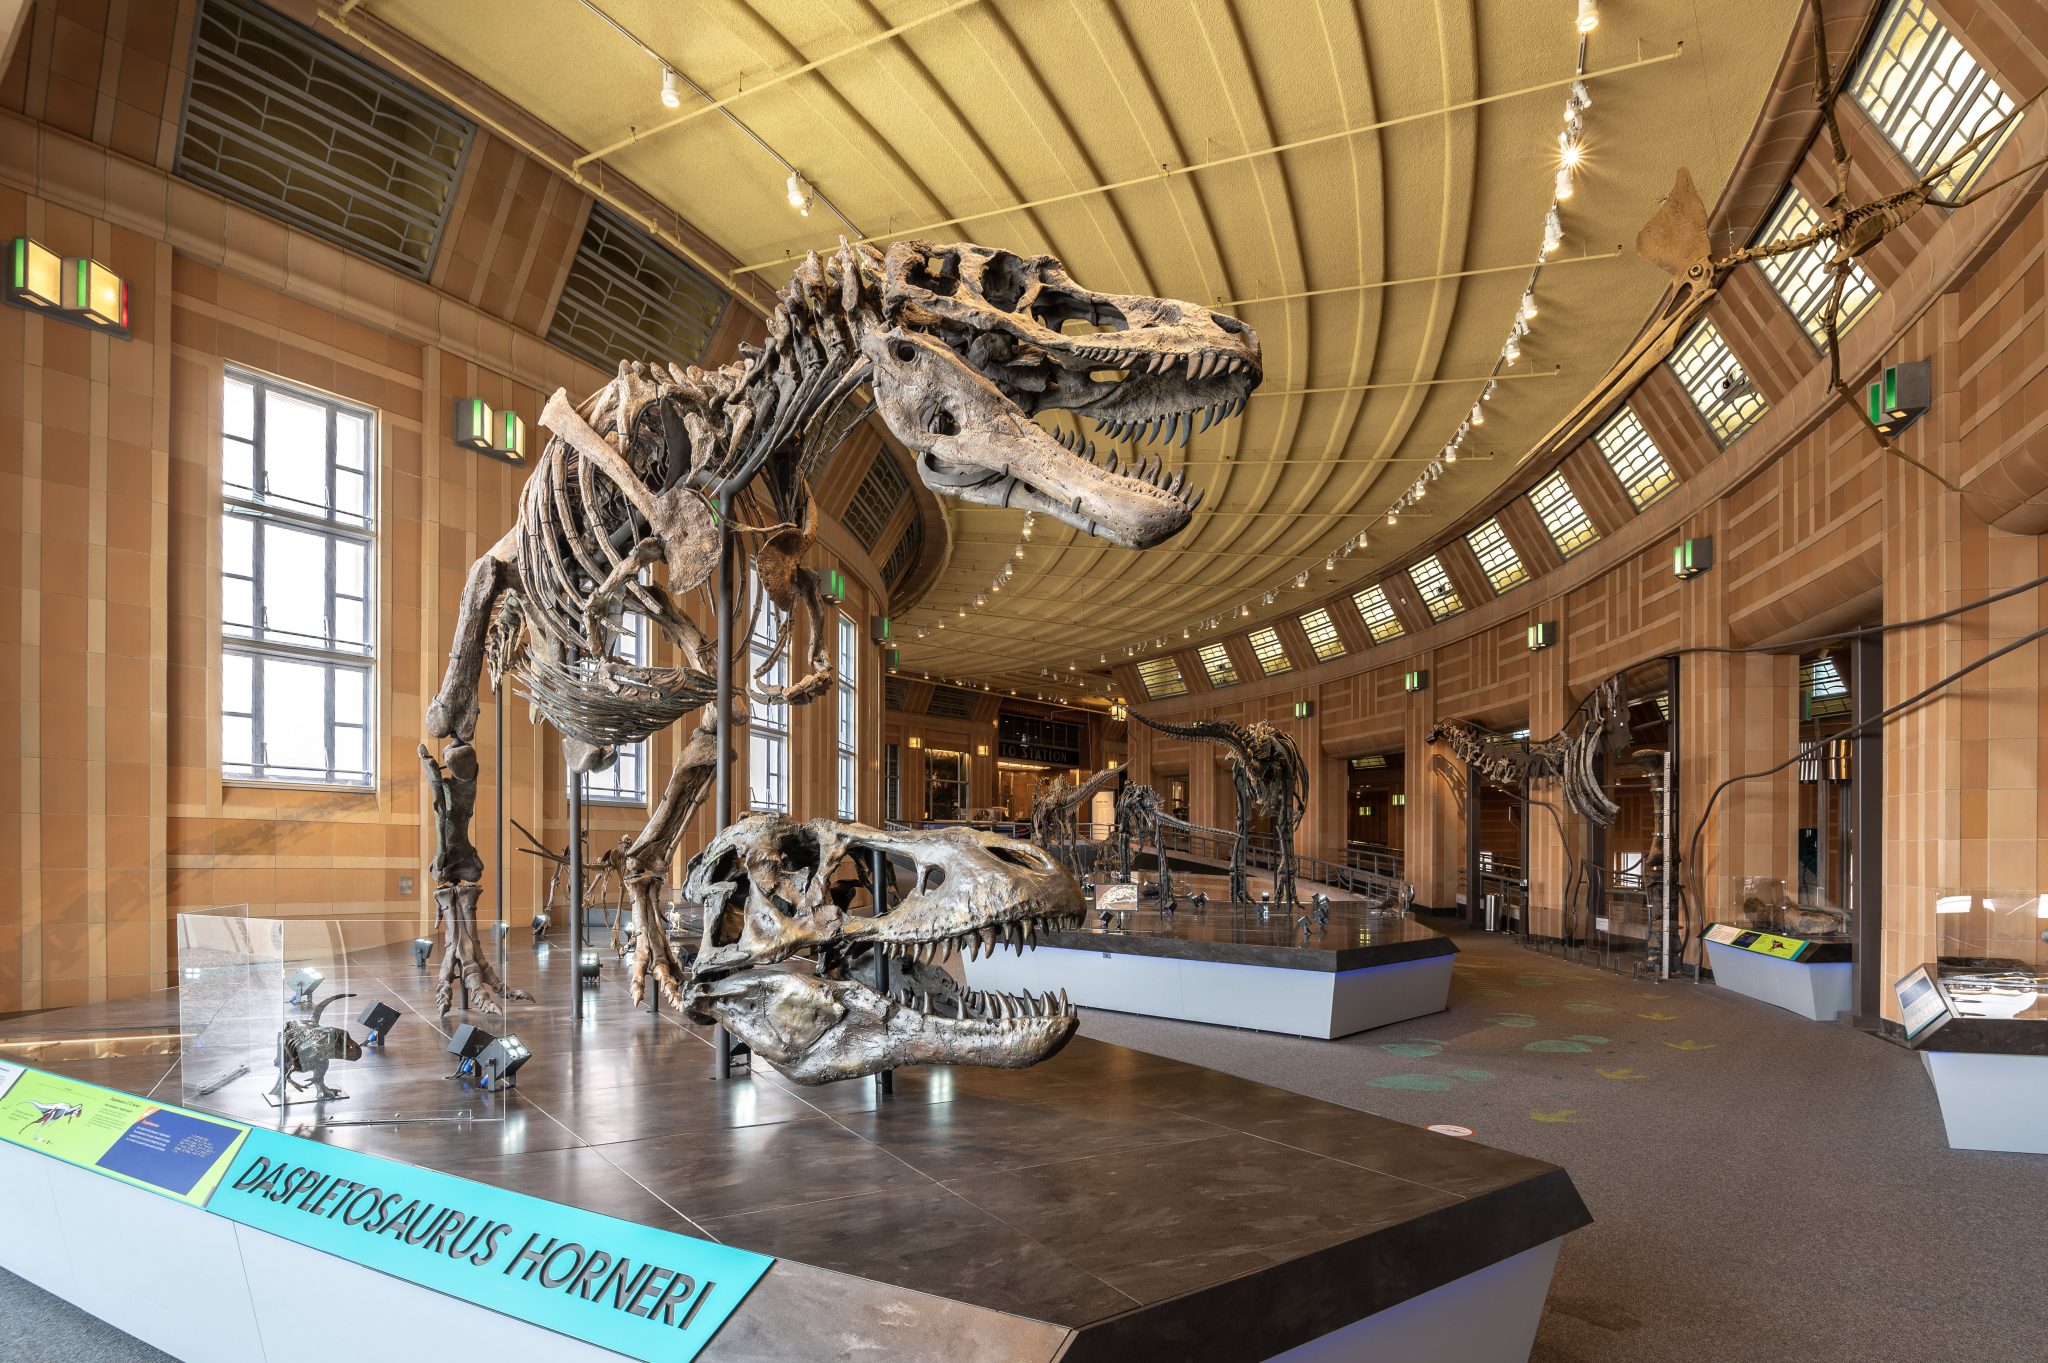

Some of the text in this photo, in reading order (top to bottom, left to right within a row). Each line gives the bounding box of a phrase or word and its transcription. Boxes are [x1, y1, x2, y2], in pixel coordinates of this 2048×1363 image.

[1001, 743, 1067, 762] TO STATION
[233, 1156, 717, 1330] DASPLETOSAURUS HORNERI
